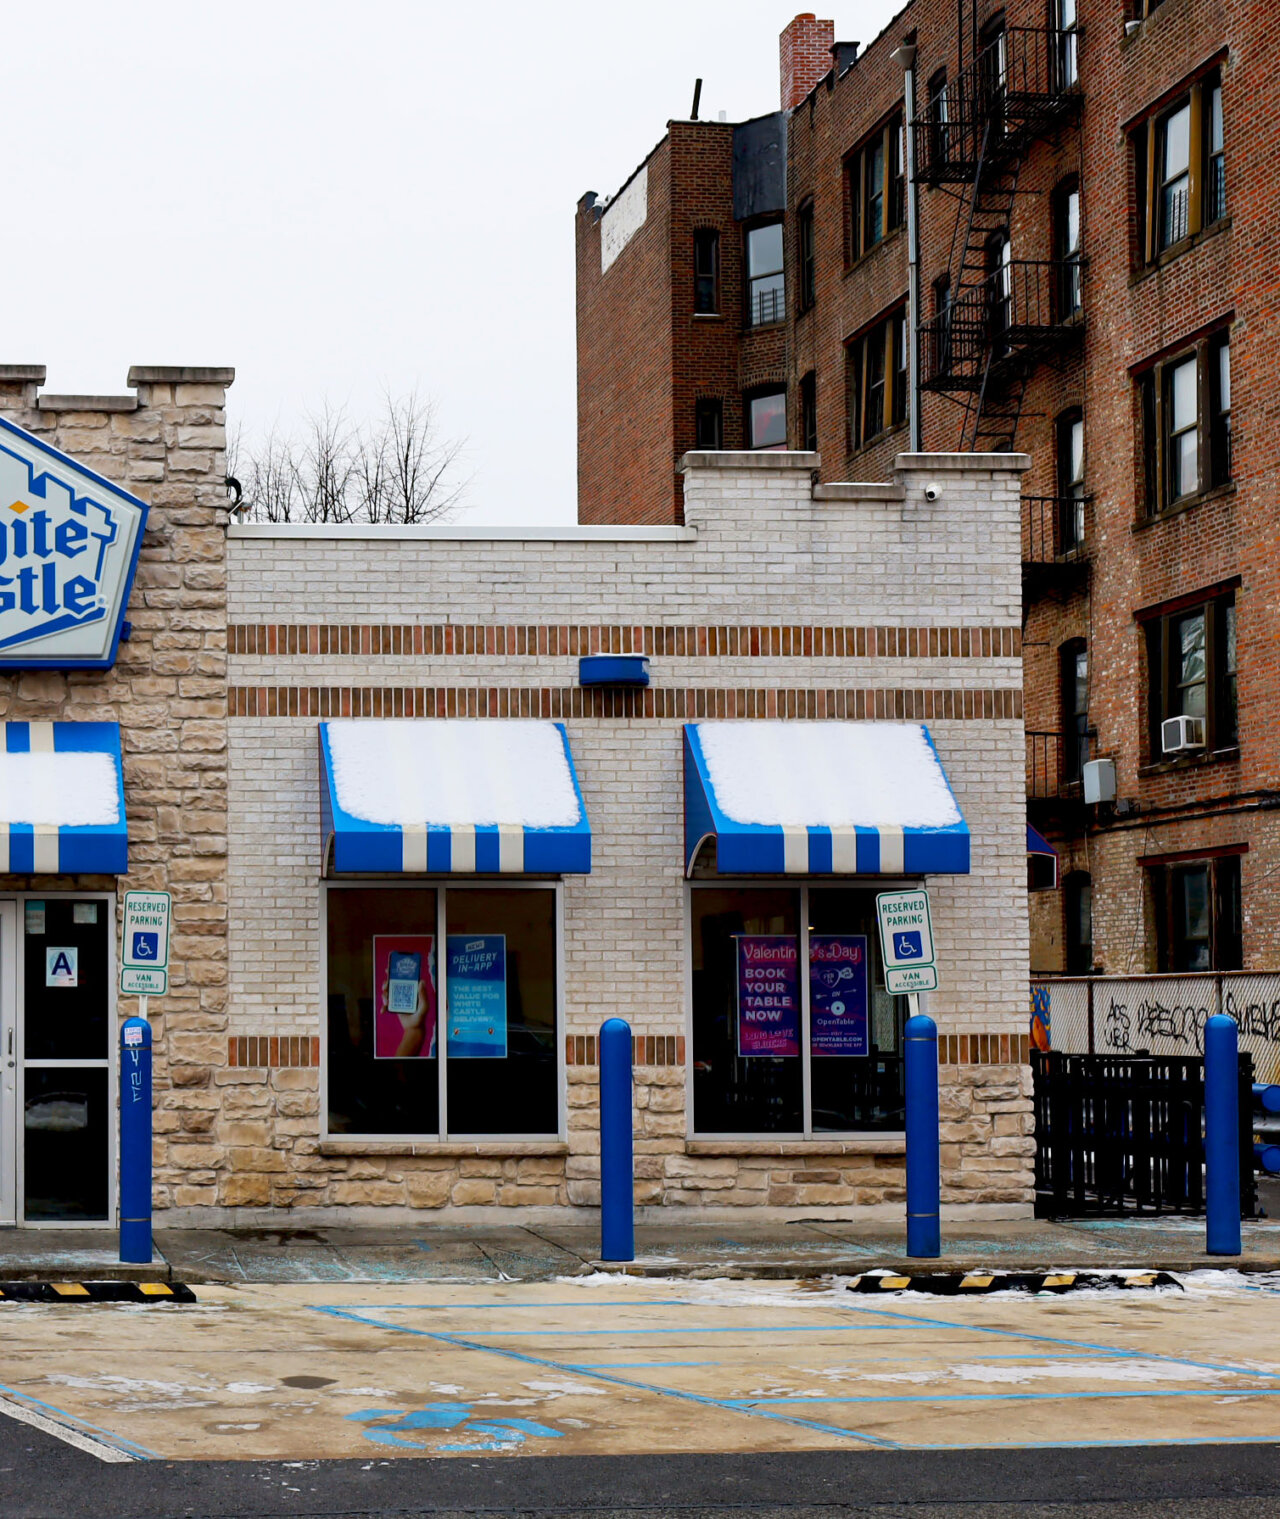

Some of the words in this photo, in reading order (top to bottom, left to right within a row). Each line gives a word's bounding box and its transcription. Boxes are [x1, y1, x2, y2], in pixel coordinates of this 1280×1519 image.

[128, 901, 167, 913] RESERVED
[882, 900, 925, 914] RESERVED
[130, 915, 163, 926] PARKING
[887, 914, 924, 927] PARKING
[826, 943, 858, 961] Day
[51, 952, 72, 975] A
[453, 952, 498, 965] DELIVERY
[458, 962, 493, 973] IN-APP
[136, 974, 152, 982] VAN
[745, 968, 786, 979] BOOK
[902, 972, 920, 980] VAN
[745, 982, 785, 993] YOUR
[895, 979, 930, 988] ACCESSIBLE
[745, 996, 792, 1007] TABLE
[745, 1010, 781, 1021] NOW
[817, 1018, 855, 1026] OpenTable
